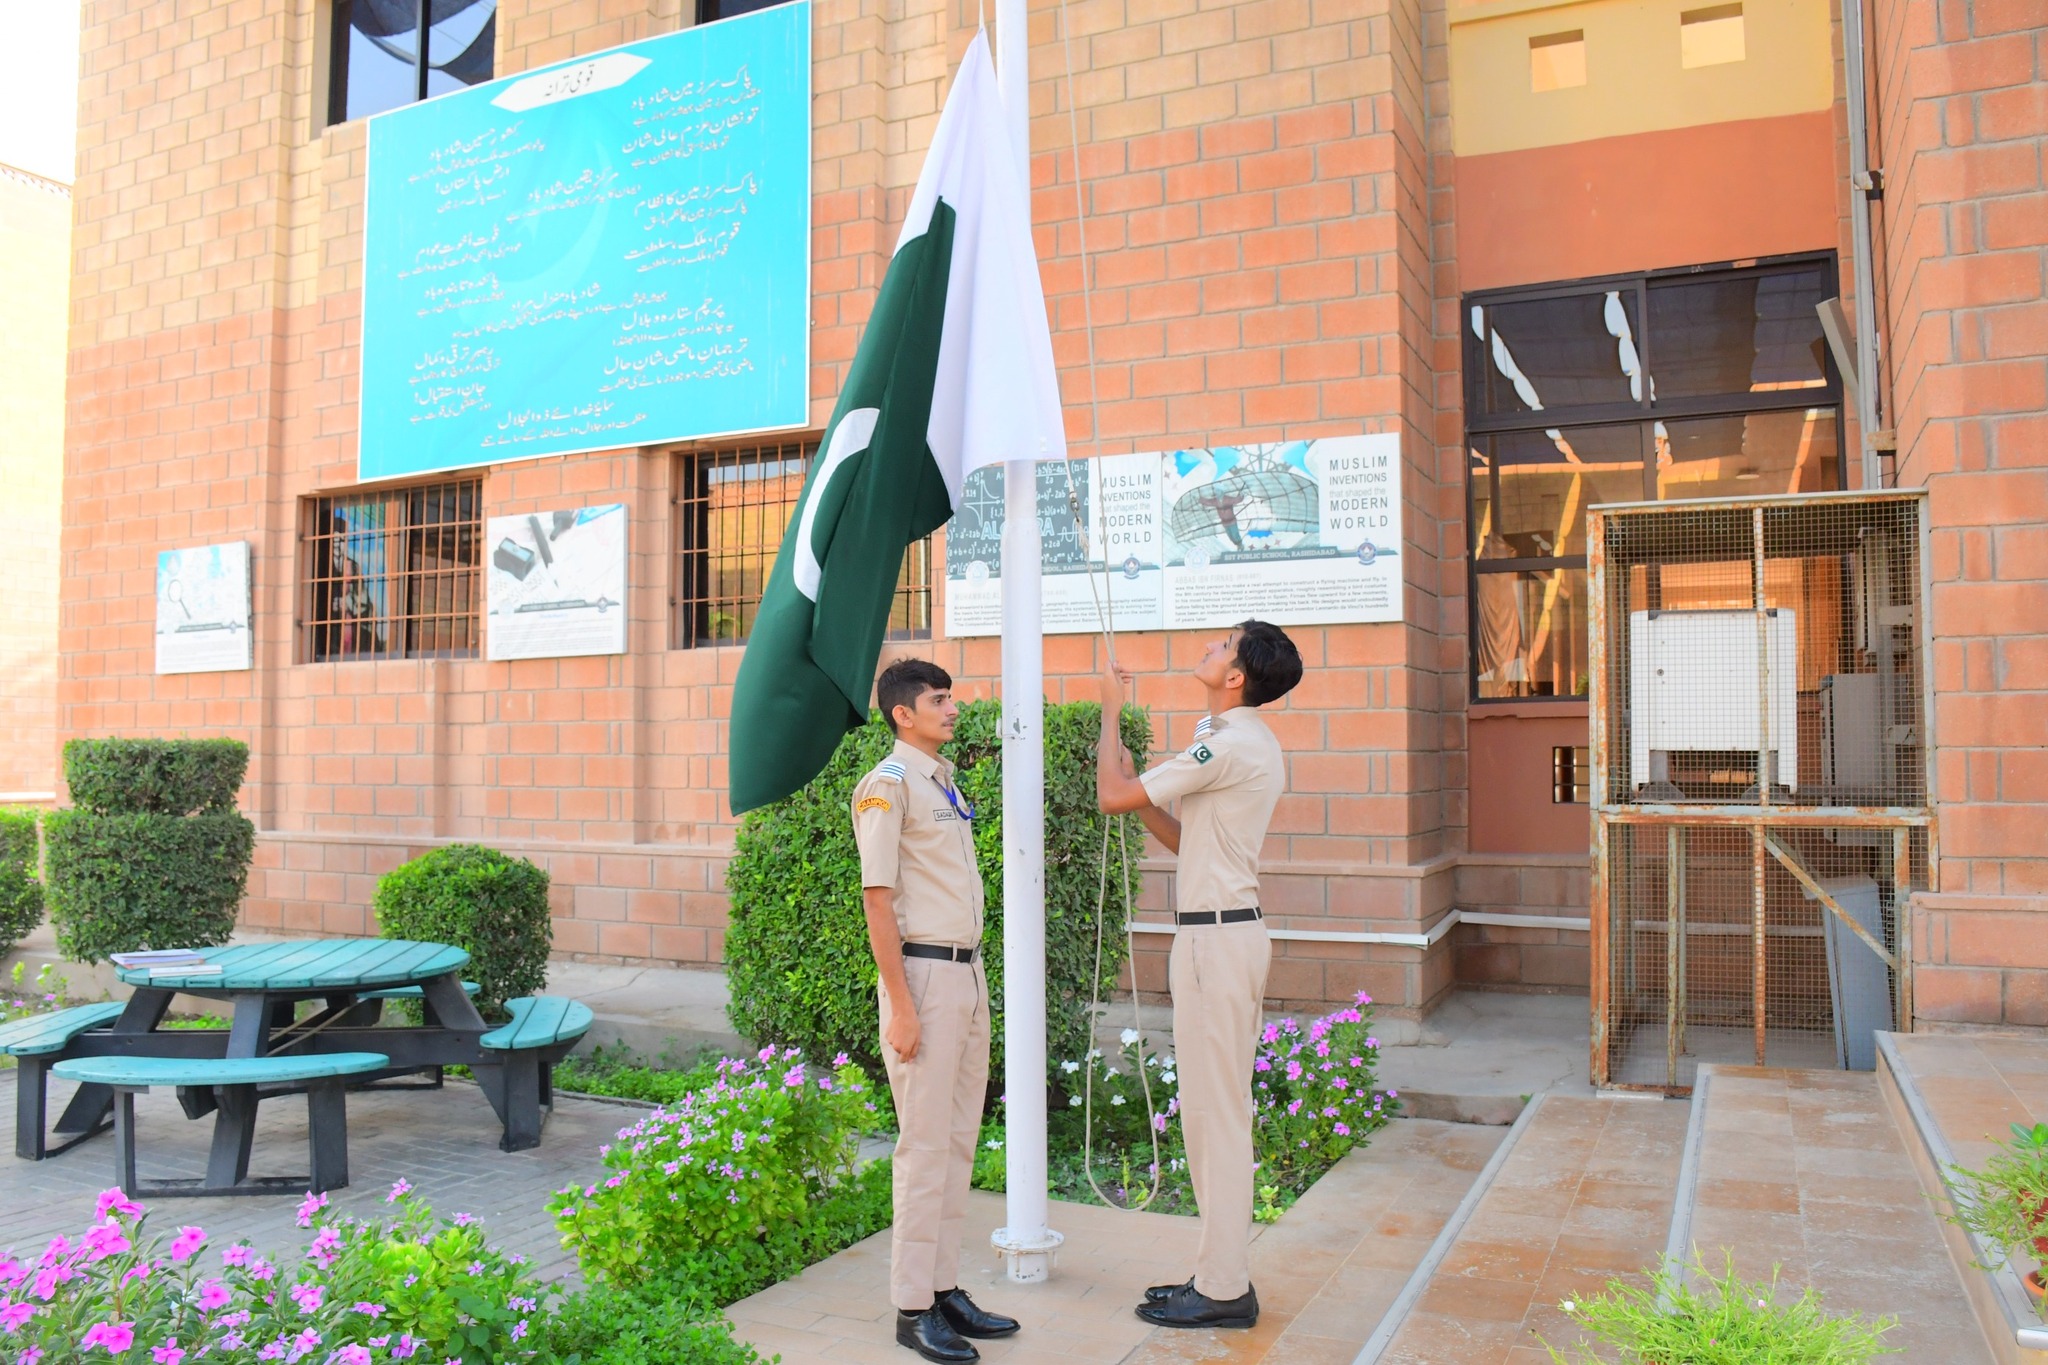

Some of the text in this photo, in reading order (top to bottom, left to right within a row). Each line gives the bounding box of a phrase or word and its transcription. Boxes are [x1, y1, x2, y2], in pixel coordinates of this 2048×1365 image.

[722, 65, 753, 90] پاک
[649, 88, 671, 106] شاد
[632, 97, 646, 112] باد
[725, 172, 759, 196] پاک
[1330, 456, 1388, 472] MUSLIM
[1330, 473, 1388, 487] INVENTIONS
[1331, 488, 1387, 499] that shaped the
[1114, 505, 1138, 514] shaped
[1140, 504, 1152, 512] the
[1331, 498, 1389, 512] MODERN
[1331, 516, 1389, 530] WORLD
[1238, 553, 1261, 561] PUBLIC
